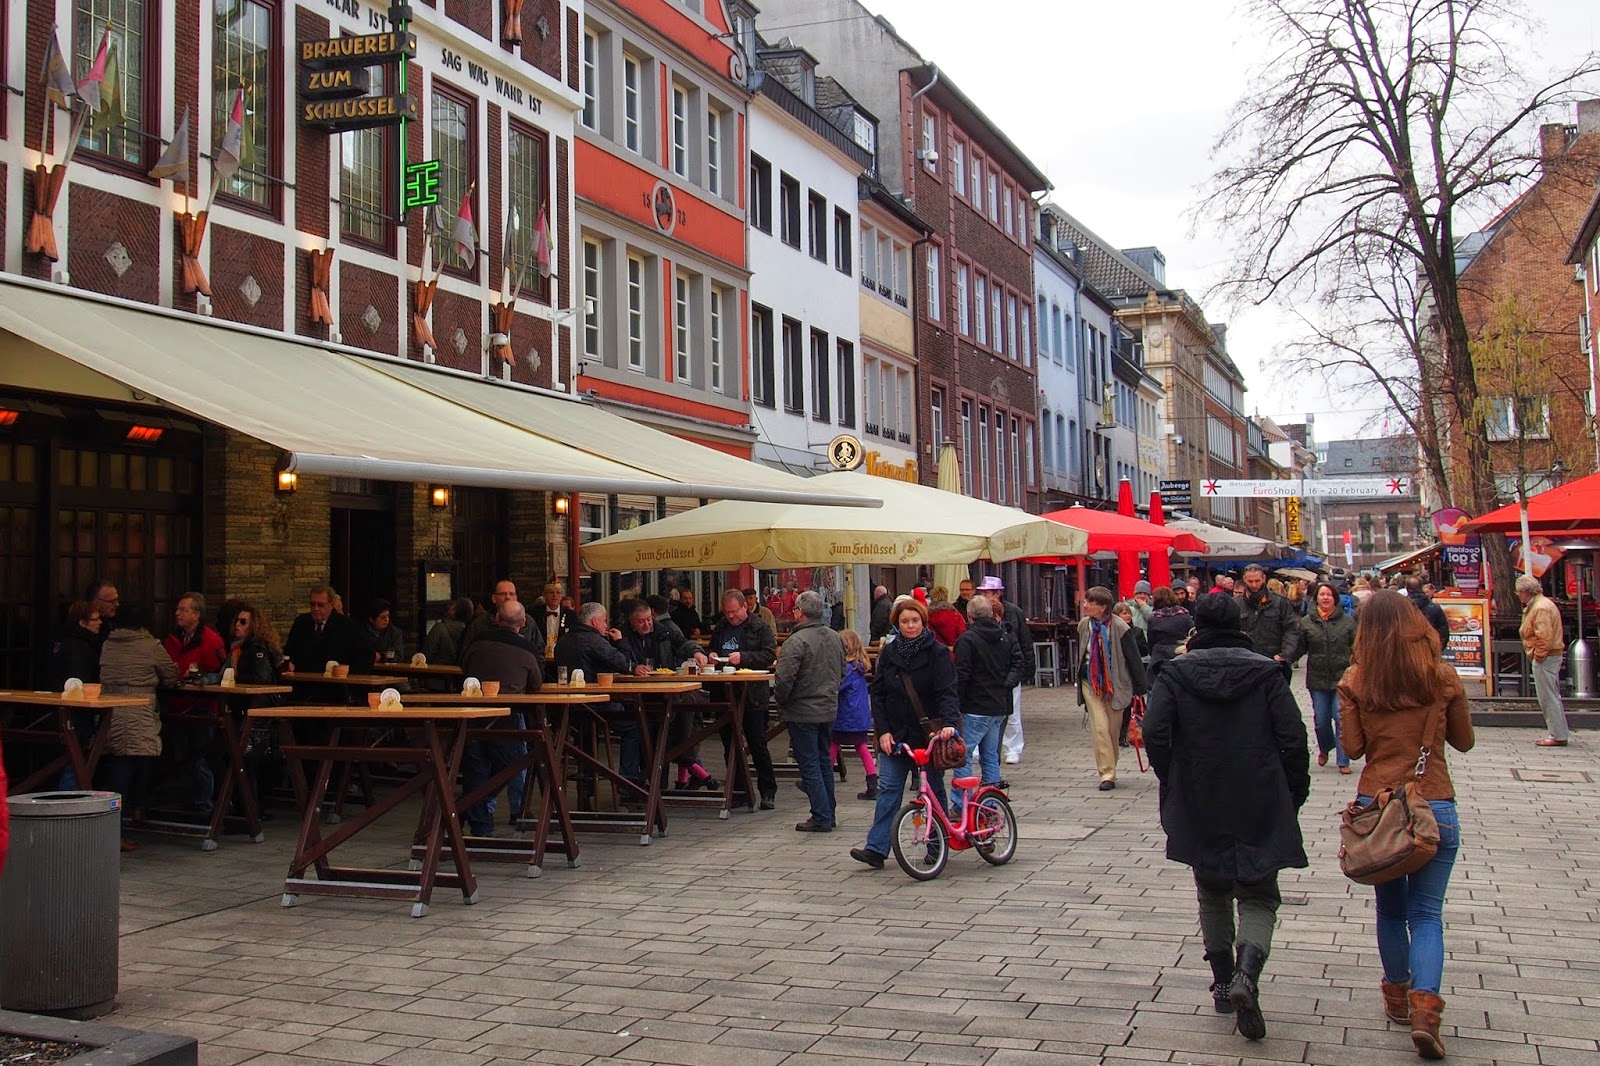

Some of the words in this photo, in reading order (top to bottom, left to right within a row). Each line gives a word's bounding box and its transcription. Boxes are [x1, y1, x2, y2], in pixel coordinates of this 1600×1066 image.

[326, 0, 360, 19] LAR
[368, 8, 387, 32] IST
[302, 34, 396, 60] BRAUEREI
[309, 70, 351, 90] ZUM
[441, 48, 462, 72] SAG
[468, 61, 489, 86] WAS
[495, 75, 523, 105] WAHR
[529, 94, 542, 115] IST
[305, 97, 396, 121] SCHLÜSSEL
[1160, 481, 1190, 491] Auberge
[1253, 487, 1296, 496] EuroShop
[1308, 487, 1318, 495] 16
[1328, 487, 1338, 495] 20
[1341, 487, 1379, 496] February
[635, 549, 655, 562] Zum
[655, 545, 695, 561] Schlüssel
[829, 542, 852, 556] Zum
[851, 540, 897, 556] Schlüssel
[1449, 635, 1480, 643] URGER
[1455, 651, 1474, 660] 5,50
[1475, 652, 1482, 660] €
